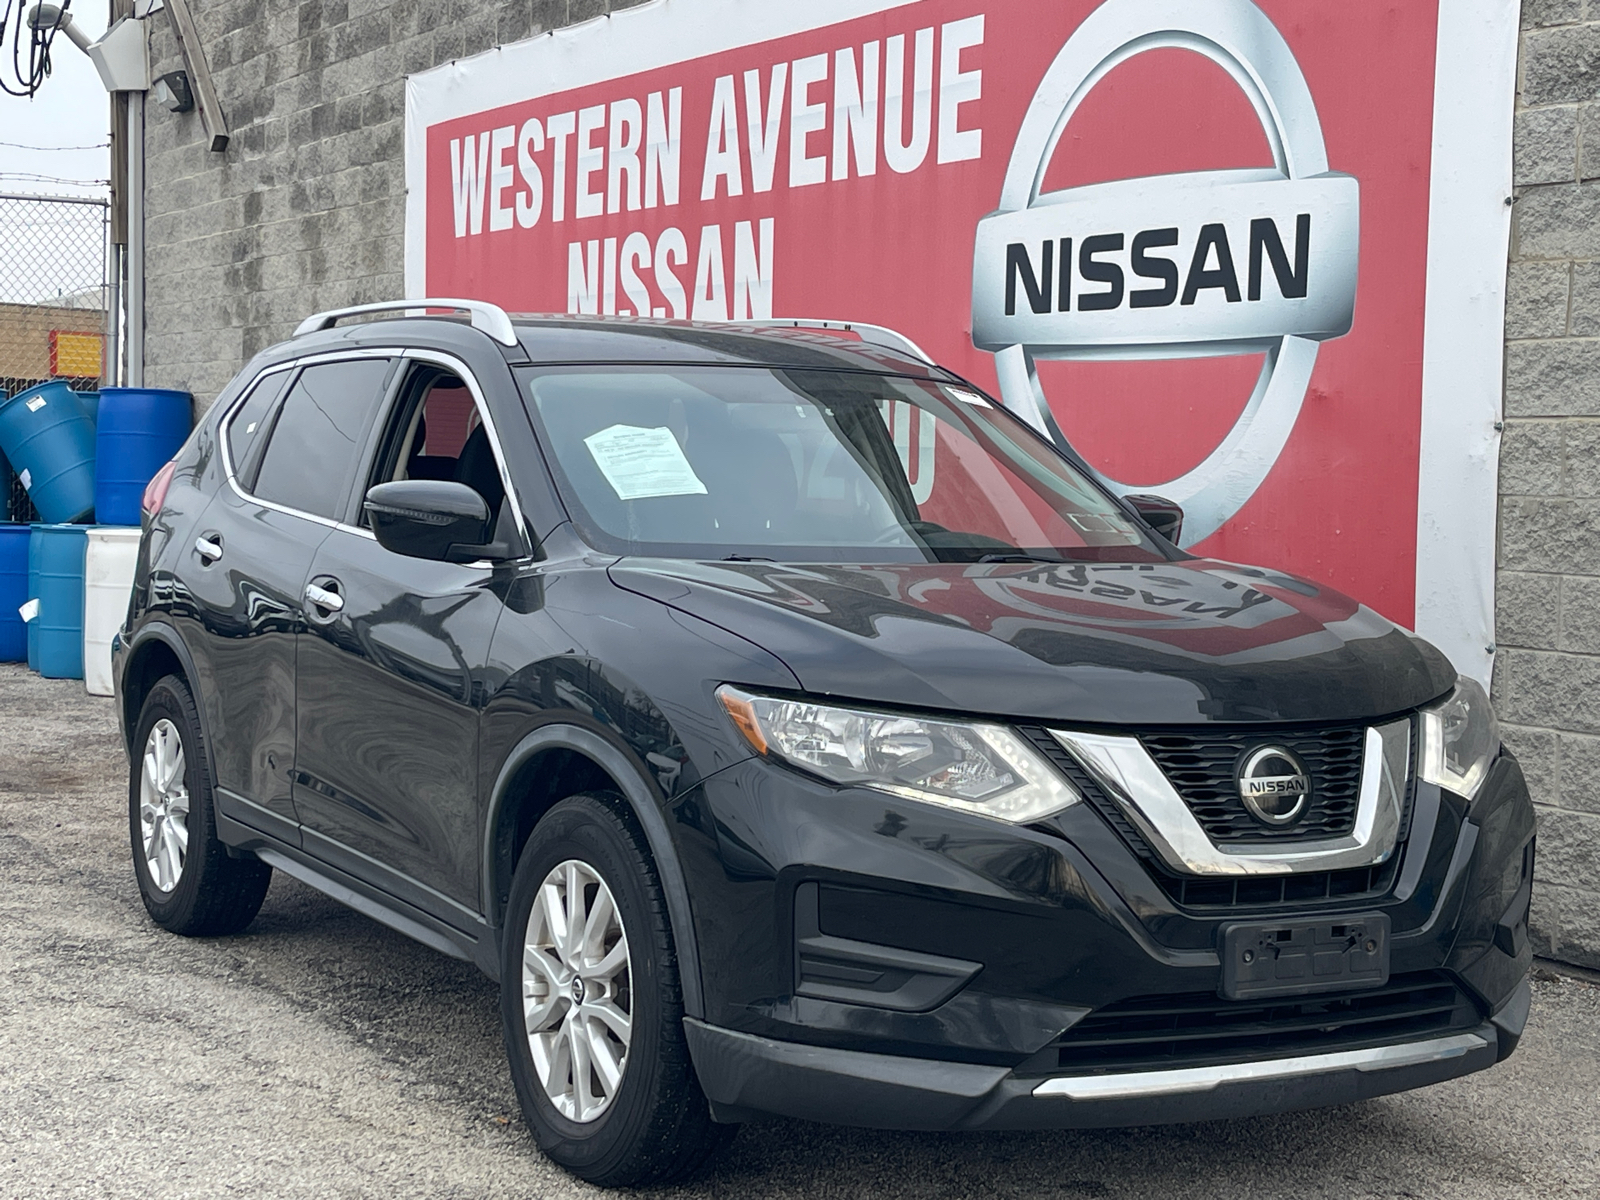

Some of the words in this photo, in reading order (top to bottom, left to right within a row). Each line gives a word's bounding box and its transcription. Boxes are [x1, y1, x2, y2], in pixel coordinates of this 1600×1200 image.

[450, 86, 683, 239] WESTERN
[700, 14, 985, 201] AVENUE
[567, 217, 775, 320] NISSAN
[1004, 213, 1310, 316] NISSAN
[1249, 779, 1305, 793] NISSAN
